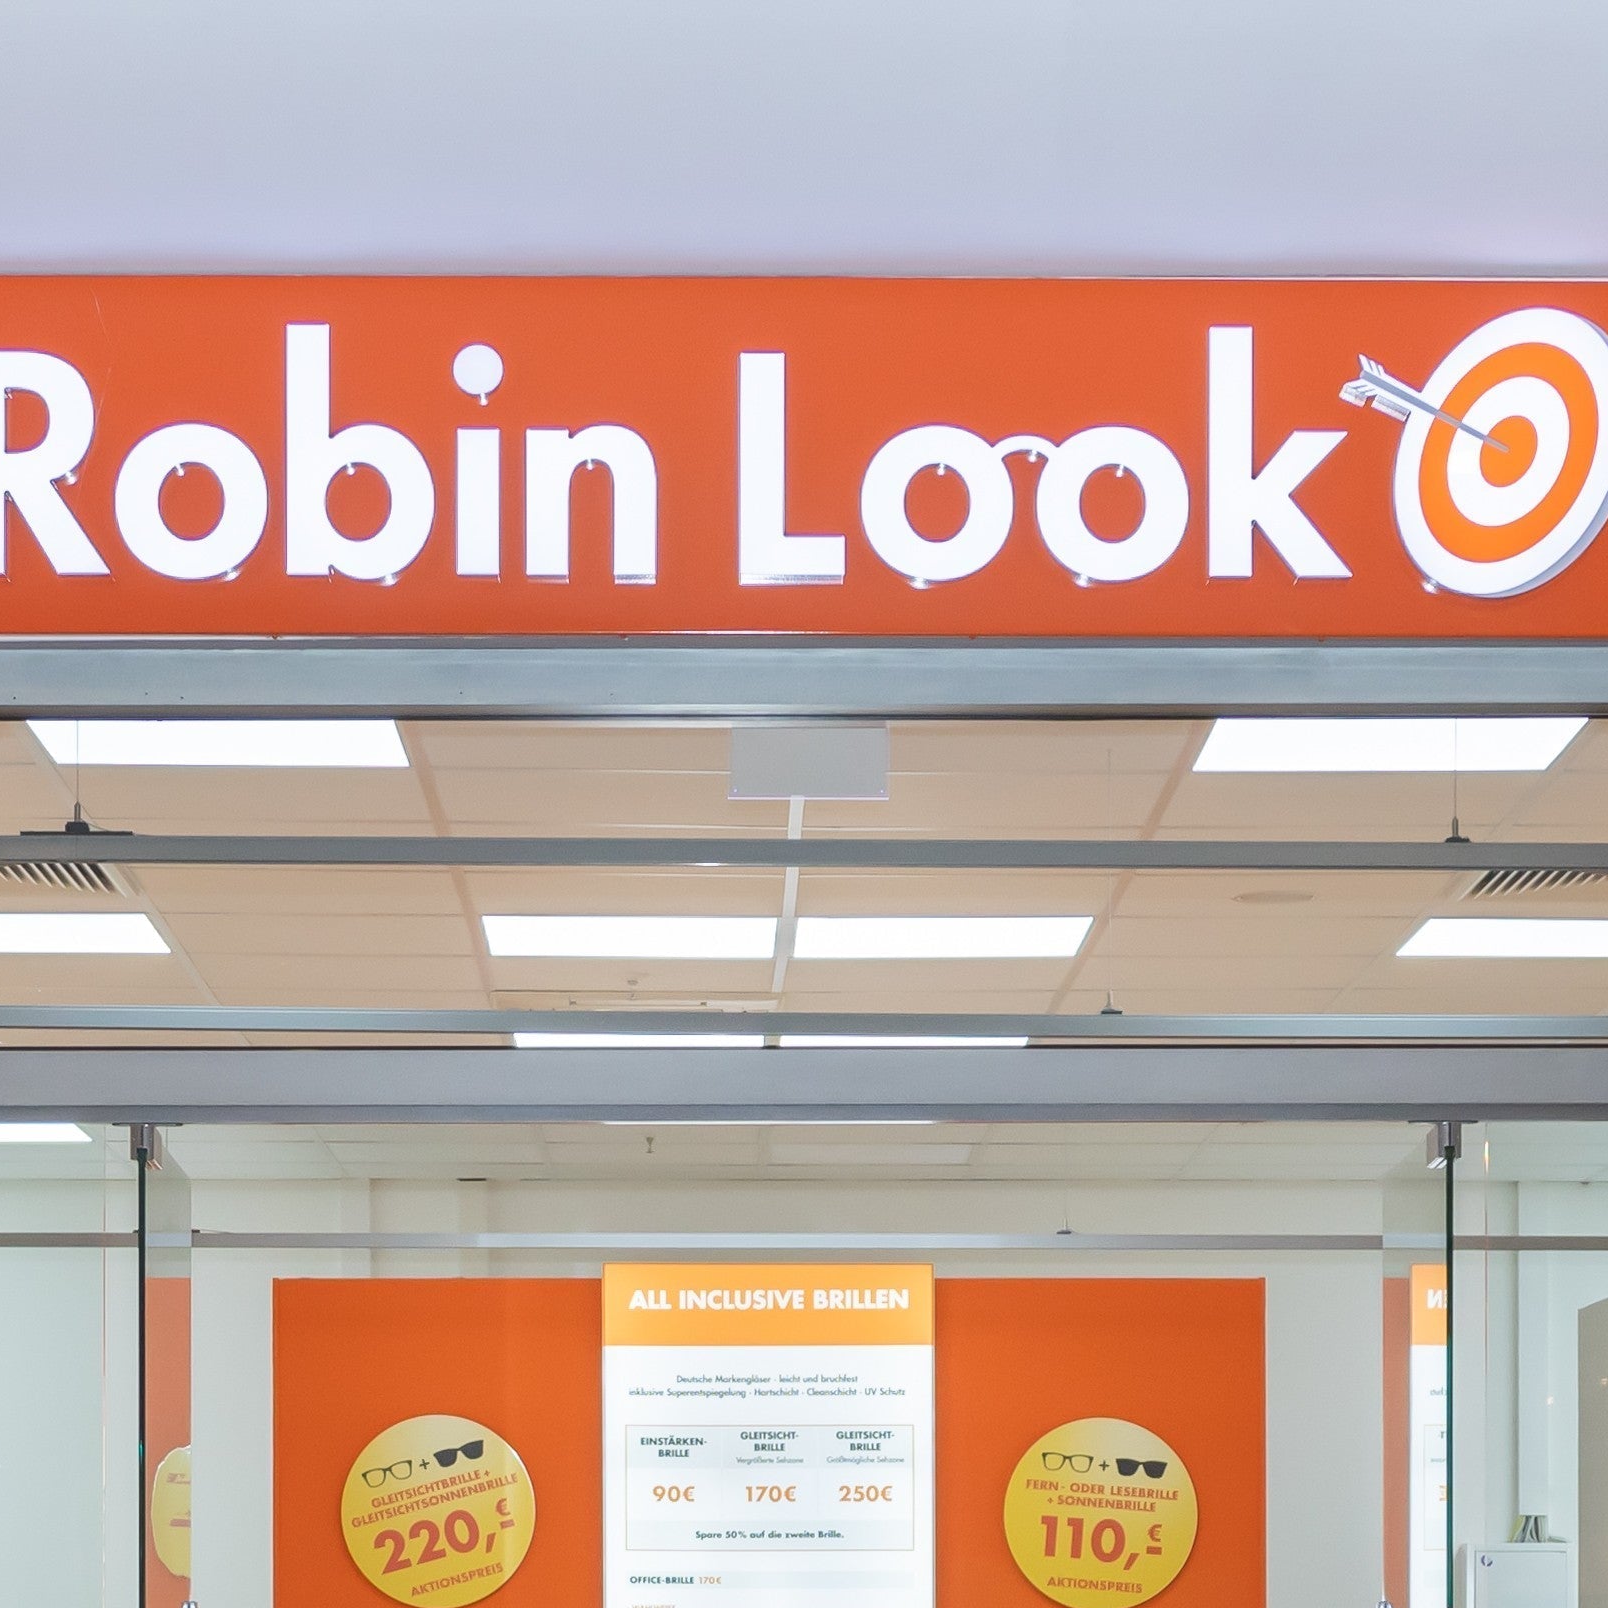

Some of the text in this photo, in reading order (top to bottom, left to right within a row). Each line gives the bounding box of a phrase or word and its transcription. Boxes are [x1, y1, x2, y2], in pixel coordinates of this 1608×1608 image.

[738, 325, 1353, 585] Look
[629, 1289, 910, 1310] ALL INCLUSIVE BRILLEN
[677, 1374, 858, 1385] Deutsche Markengläser leicht und bruchfest
[754, 1388, 799, 1396] Hartschicht
[641, 1435, 707, 1446] EINSTÄRKEN-
[740, 1431, 799, 1440] GLEITSICHT-
[836, 1431, 895, 1440] GLEITSICHT-
[658, 1450, 689, 1458] BRILLE
[754, 1443, 785, 1451] BRILLE
[850, 1443, 881, 1451] BRILLE
[371, 1470, 482, 1508] GLEITSICHTBRILLE
[653, 1486, 695, 1502] 90€
[745, 1486, 797, 1502] 170€
[839, 1486, 893, 1502] 250€
[1070, 1482, 1179, 1500] ODER LESEBRILLE
[351, 1473, 519, 1528] GLEITSICHTSONNENBRILLE
[1057, 1495, 1156, 1512] SONNENBRILLE
[695, 1531, 722, 1540] Spare
[411, 1563, 503, 1596] AKTIONSPREIS
[1047, 1576, 1142, 1593] AKTIONSPREIS
